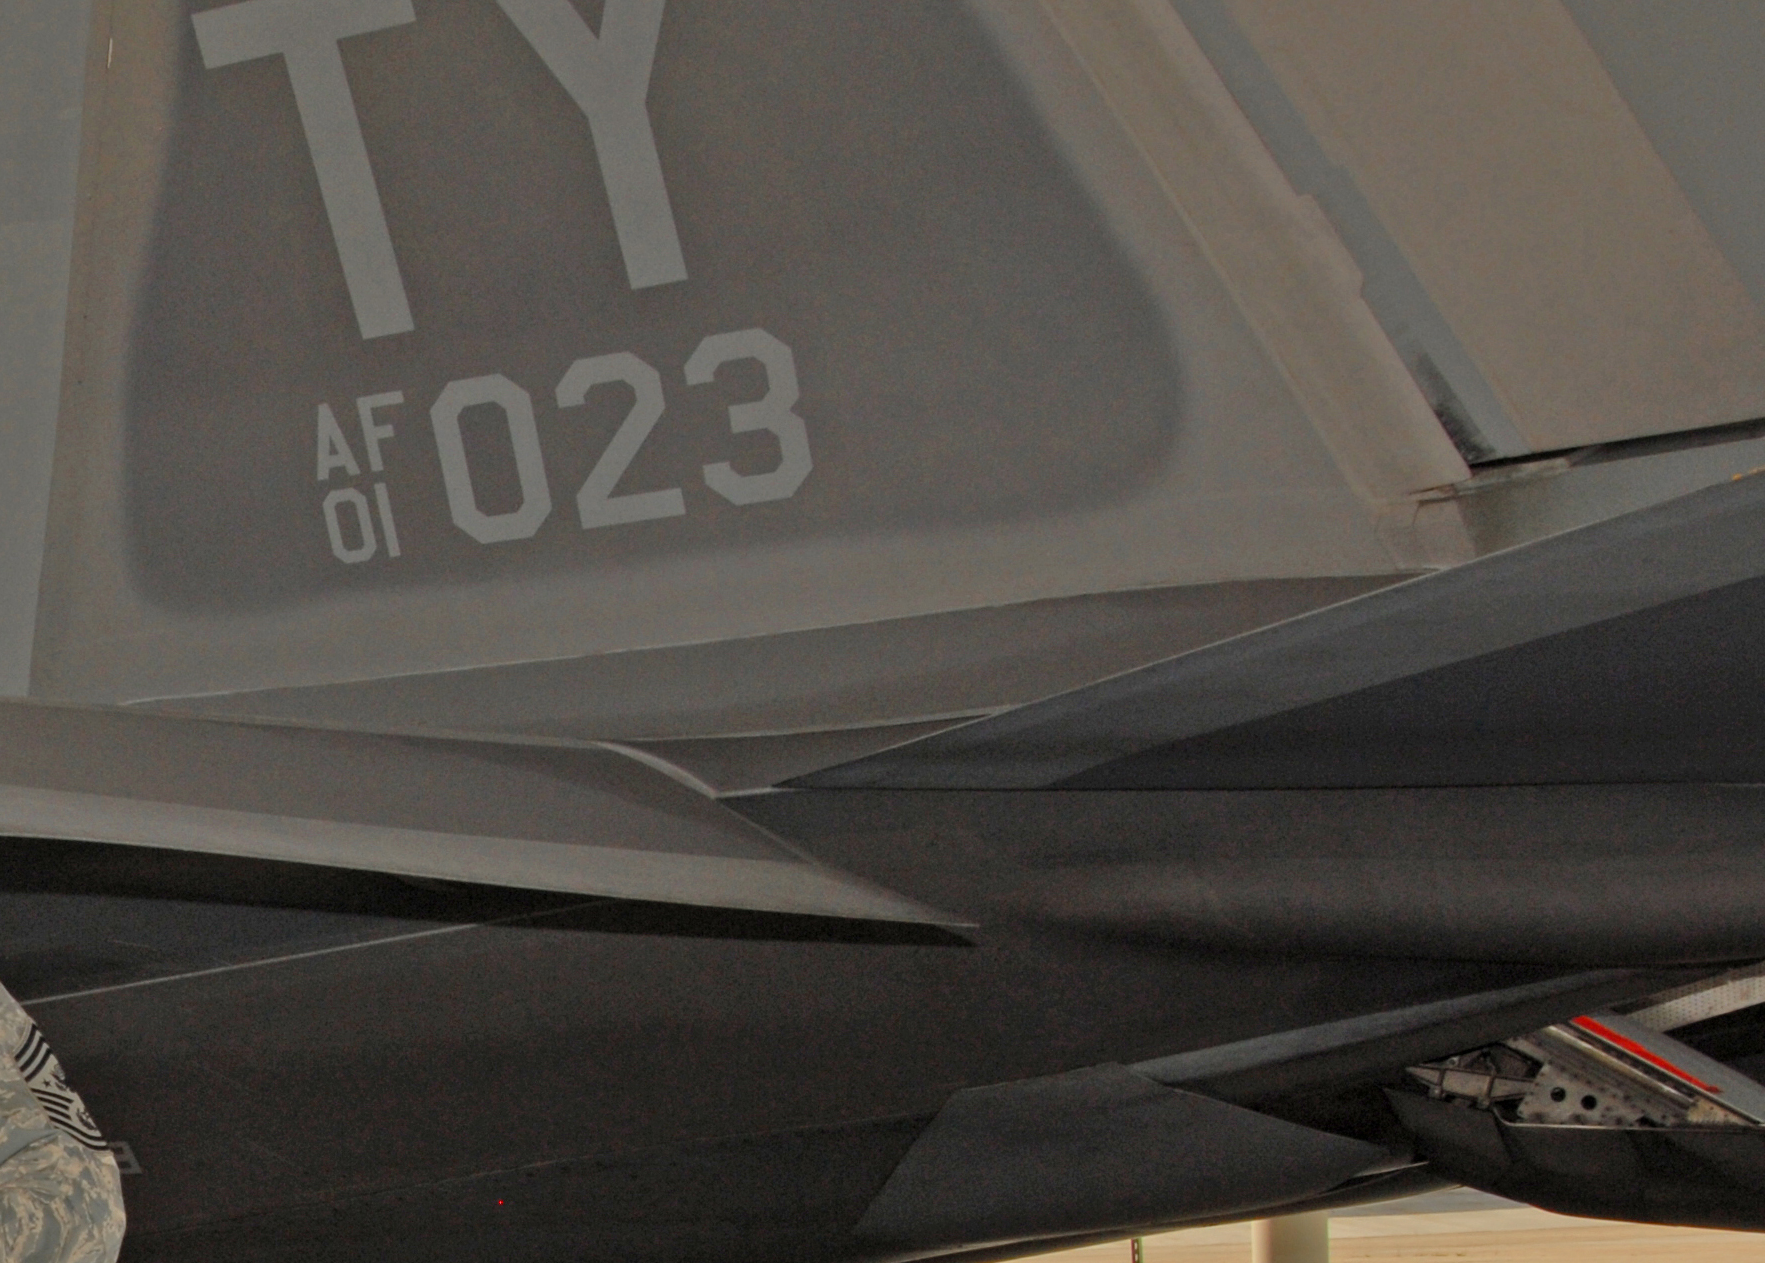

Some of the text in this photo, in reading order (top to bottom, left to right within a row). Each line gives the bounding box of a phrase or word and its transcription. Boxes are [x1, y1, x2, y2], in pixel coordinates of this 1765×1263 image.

[191, 0, 688, 340] TY
[316, 391, 405, 481] AF
[430, 328, 814, 545] 023
